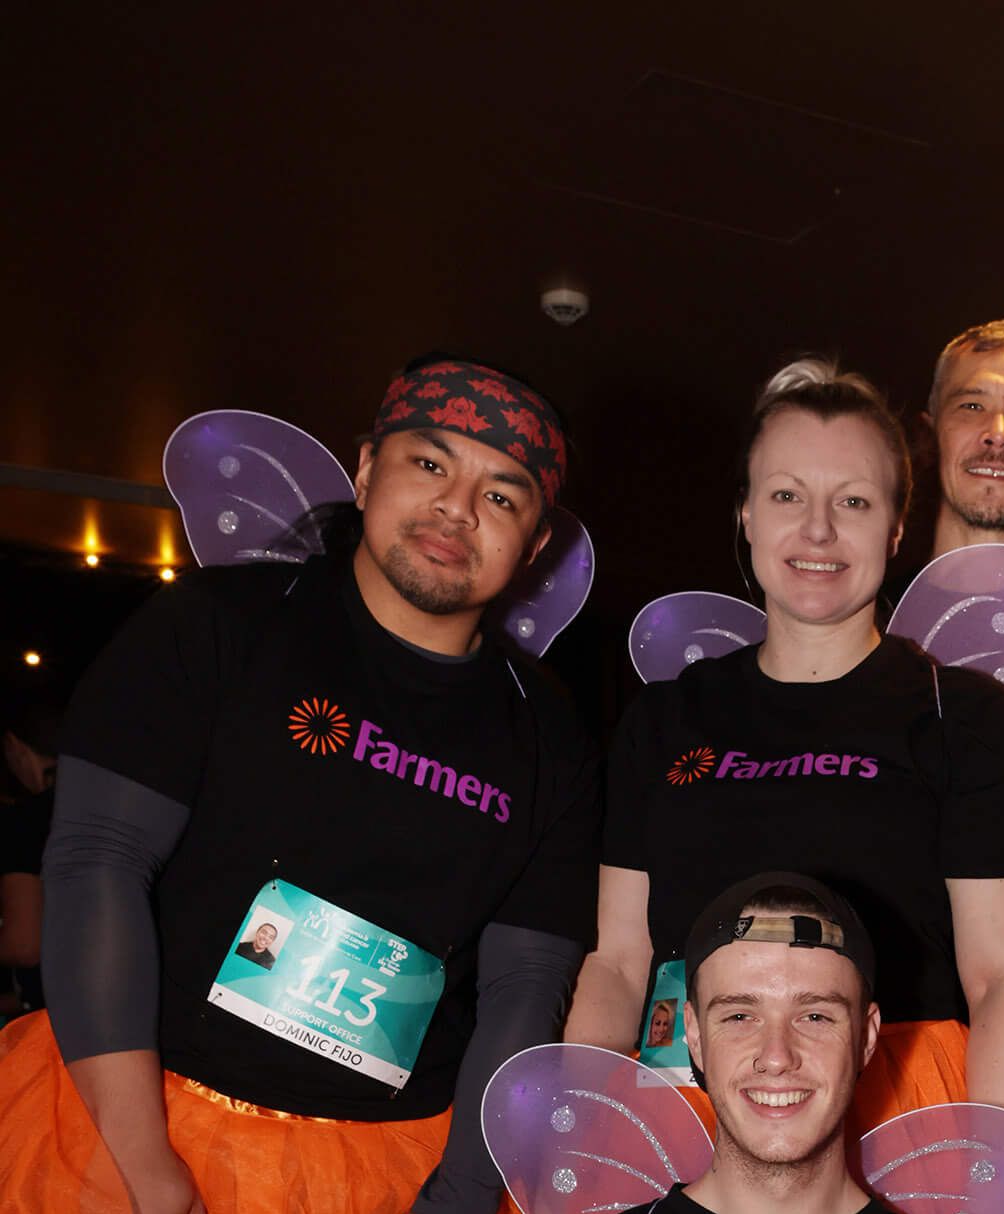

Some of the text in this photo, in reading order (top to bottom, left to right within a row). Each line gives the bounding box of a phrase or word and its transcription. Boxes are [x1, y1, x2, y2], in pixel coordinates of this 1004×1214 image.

[353, 719, 512, 823] Farmers
[715, 751, 879, 779] Farmers
[286, 955, 387, 1027] 113
[263, 1013, 363, 1066] DOMINIC FIJO
[328, 1024, 363, 1045] OFFICE
